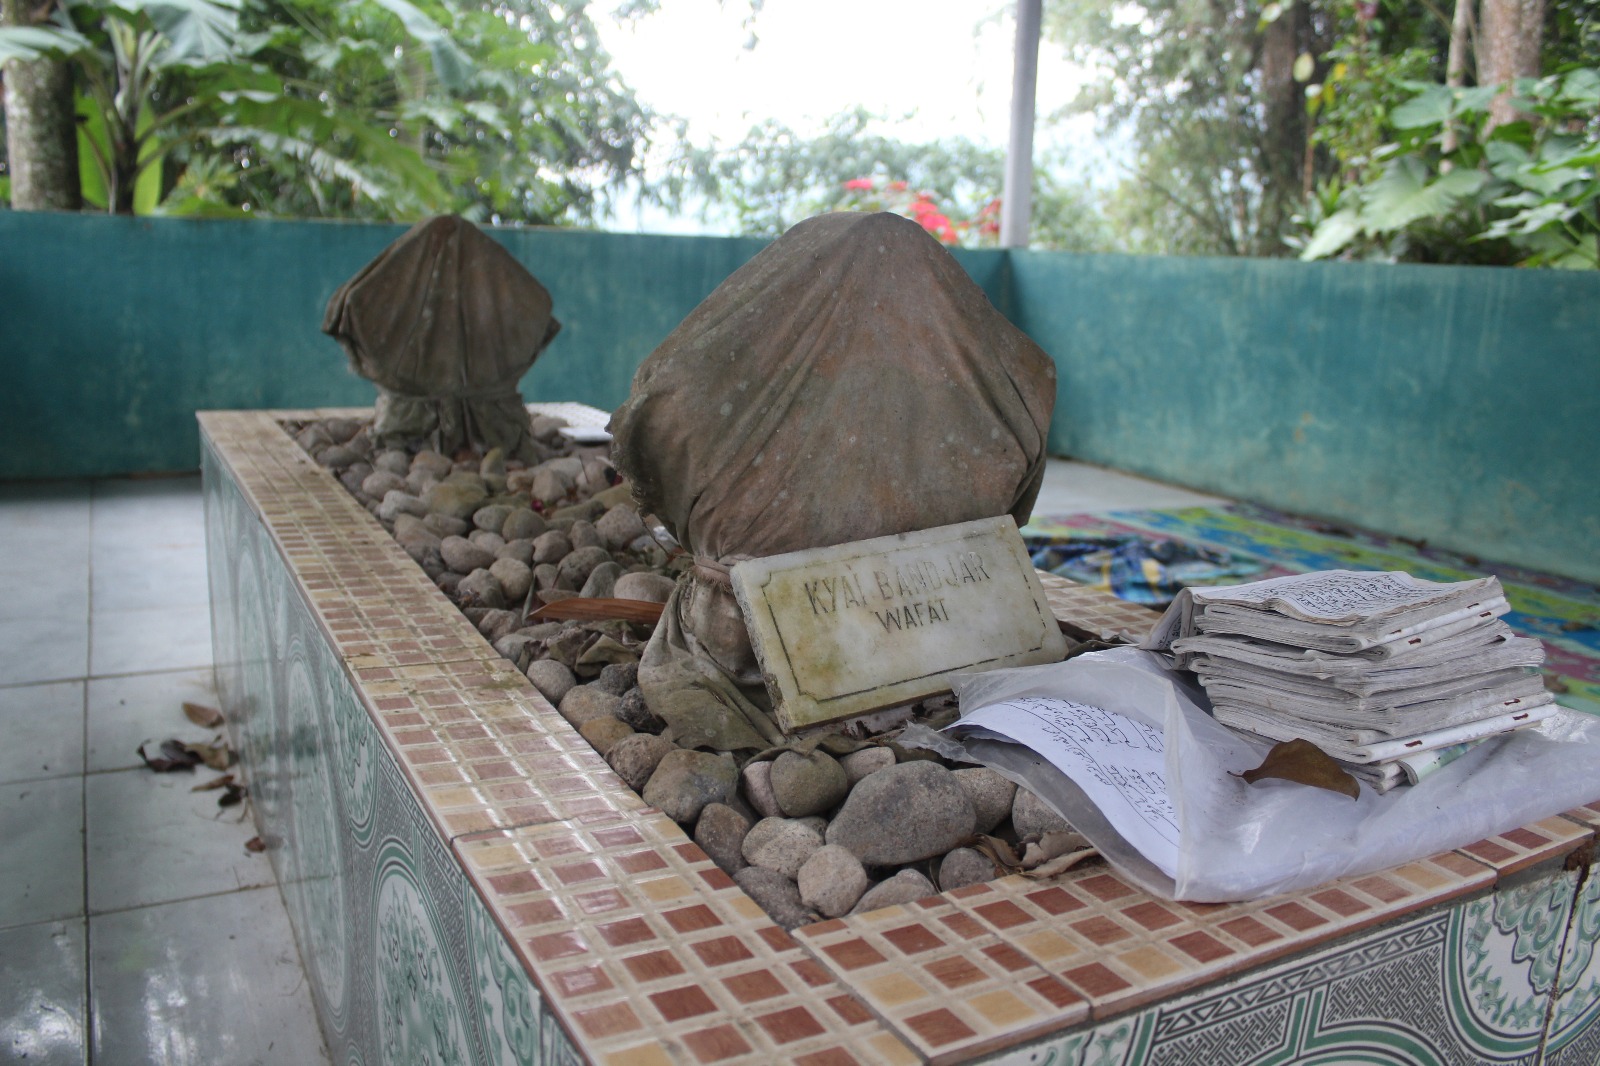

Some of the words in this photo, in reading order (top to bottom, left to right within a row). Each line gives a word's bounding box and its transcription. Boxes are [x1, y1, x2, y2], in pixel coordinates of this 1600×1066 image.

[804, 573, 867, 615] KYAI
[873, 552, 990, 600] BANDJAR
[874, 598, 949, 633] WAFAT
